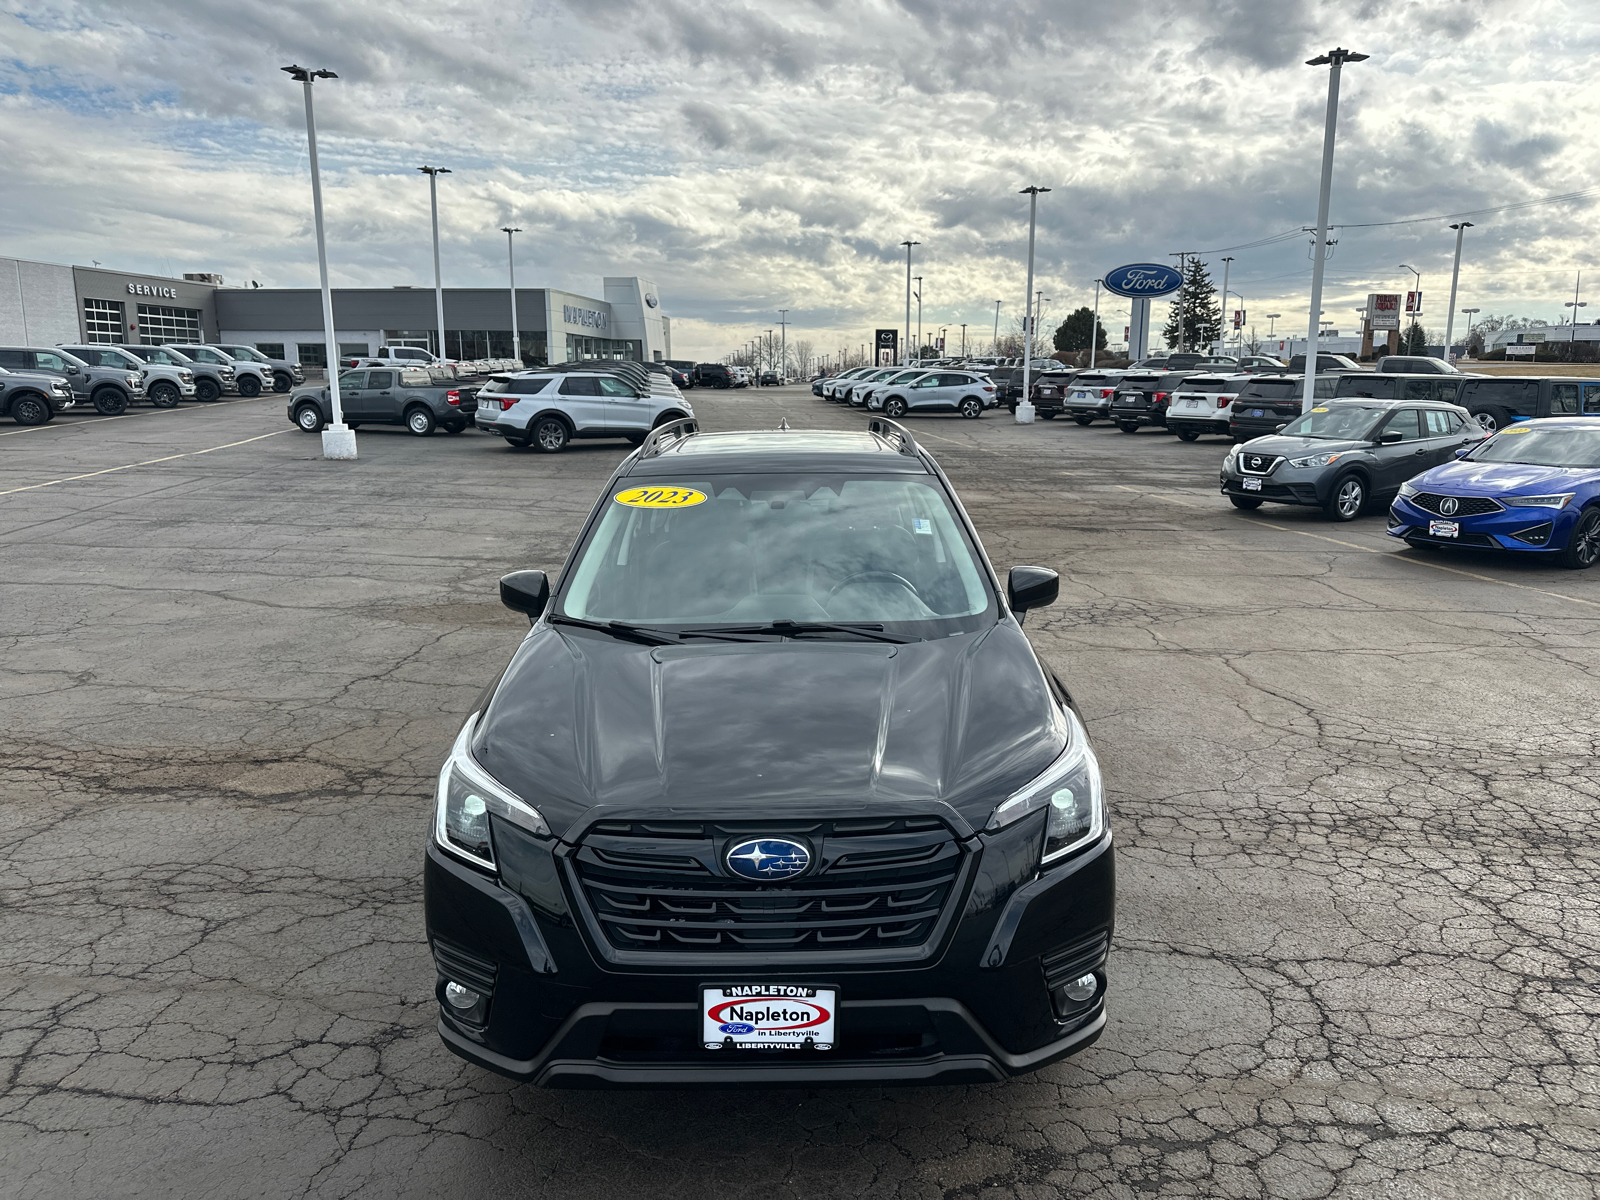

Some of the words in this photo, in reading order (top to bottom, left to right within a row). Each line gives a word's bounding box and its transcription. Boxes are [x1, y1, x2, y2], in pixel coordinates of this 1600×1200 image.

[1121, 269, 1169, 290] Ford
[128, 283, 177, 298] SERVICE
[563, 304, 608, 329] NAPLETON
[626, 490, 694, 503] 2023
[731, 985, 808, 997] NAPLETON
[730, 1006, 811, 1025] Napleton
[726, 1024, 749, 1034] Ford
[736, 1042, 802, 1050] LIBERTYVILLE
